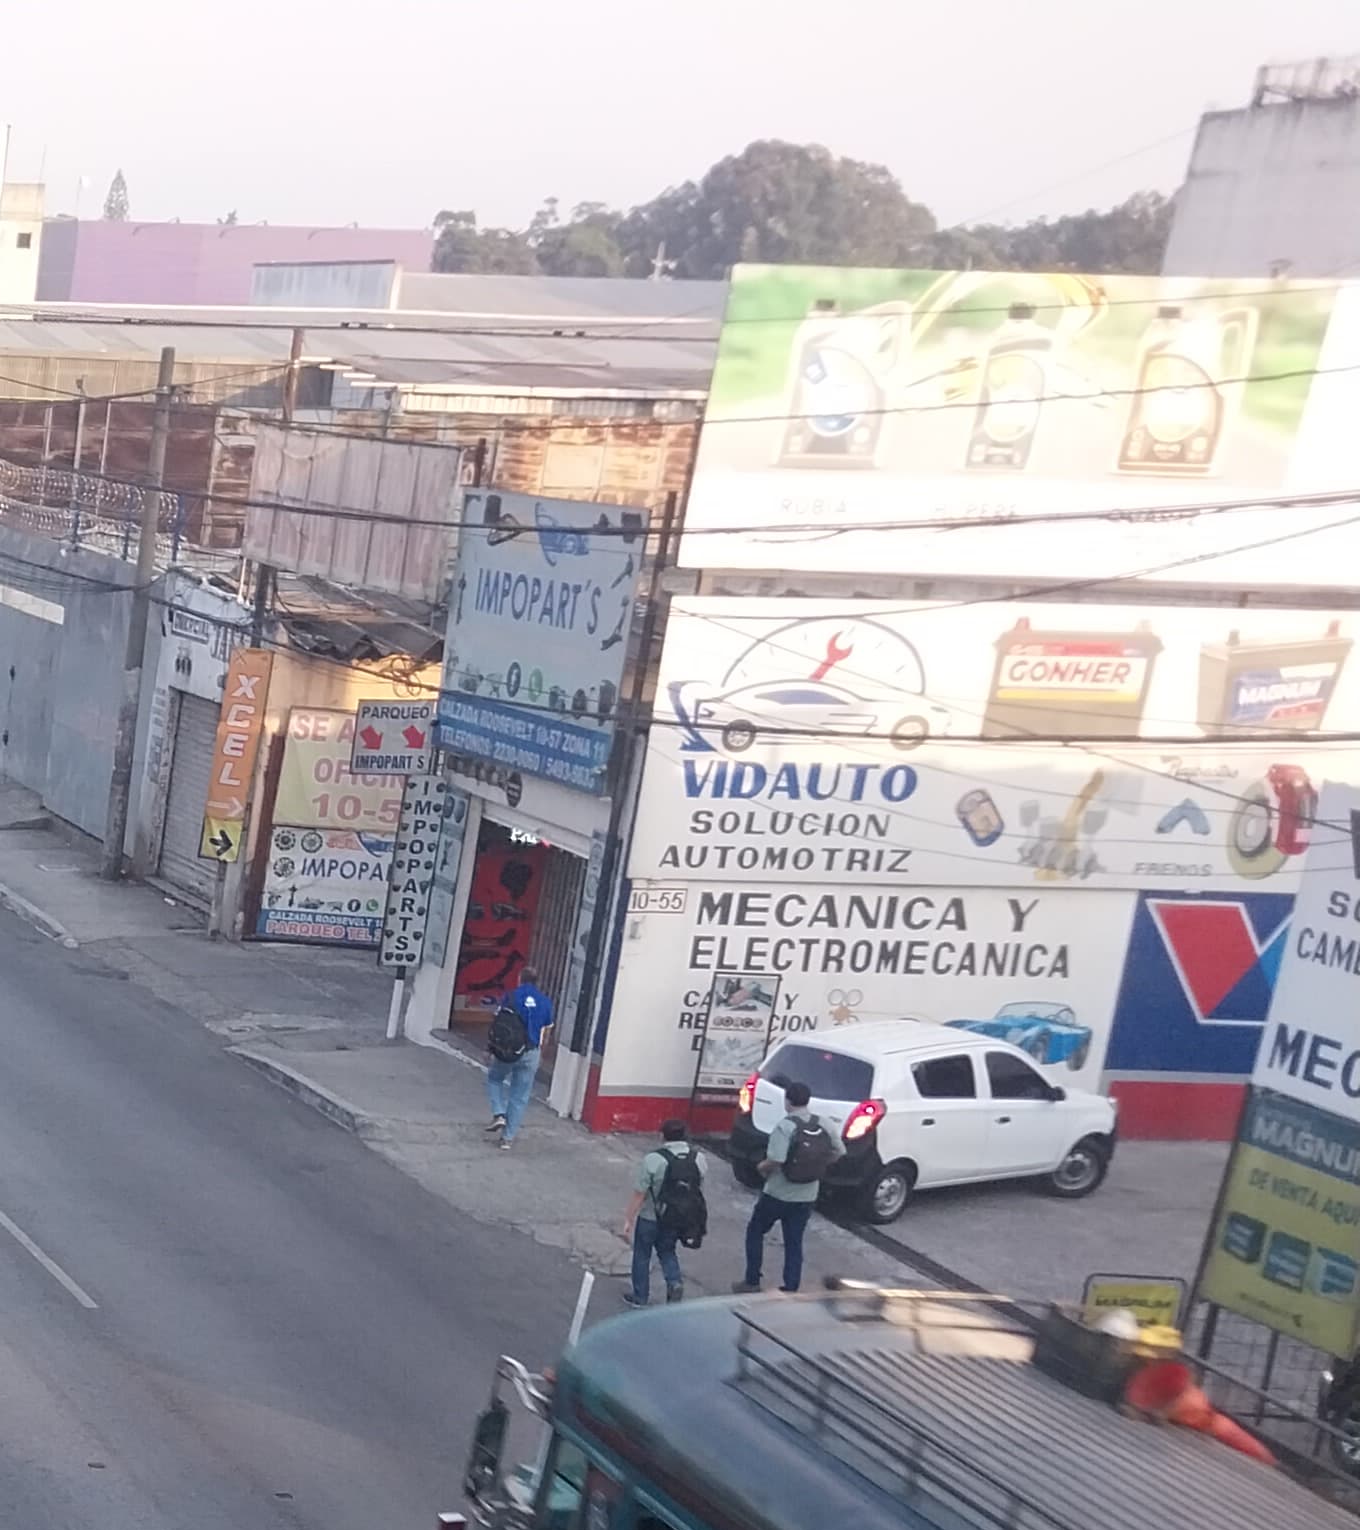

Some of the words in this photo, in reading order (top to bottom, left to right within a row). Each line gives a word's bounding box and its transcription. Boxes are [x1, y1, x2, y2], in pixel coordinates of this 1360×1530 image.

[1008, 660, 1132, 685] GONHER
[361, 706, 430, 720] PARQUEO
[293, 716, 330, 742] SE
[683, 759, 918, 801] VIDAUTO
[689, 810, 892, 837] SOLUCION
[659, 845, 913, 873] AUTOMOTRIZ
[1134, 862, 1213, 878] FRENOS
[631, 891, 683, 911] 10-55
[696, 891, 968, 932] MECANICA
[1008, 899, 1039, 933] Y
[265, 920, 346, 940] PARQUEO
[268, 911, 315, 924] CALZADA
[315, 915, 372, 928] ROOSEVELT
[689, 935, 1071, 980] ELECTROMECANICA
